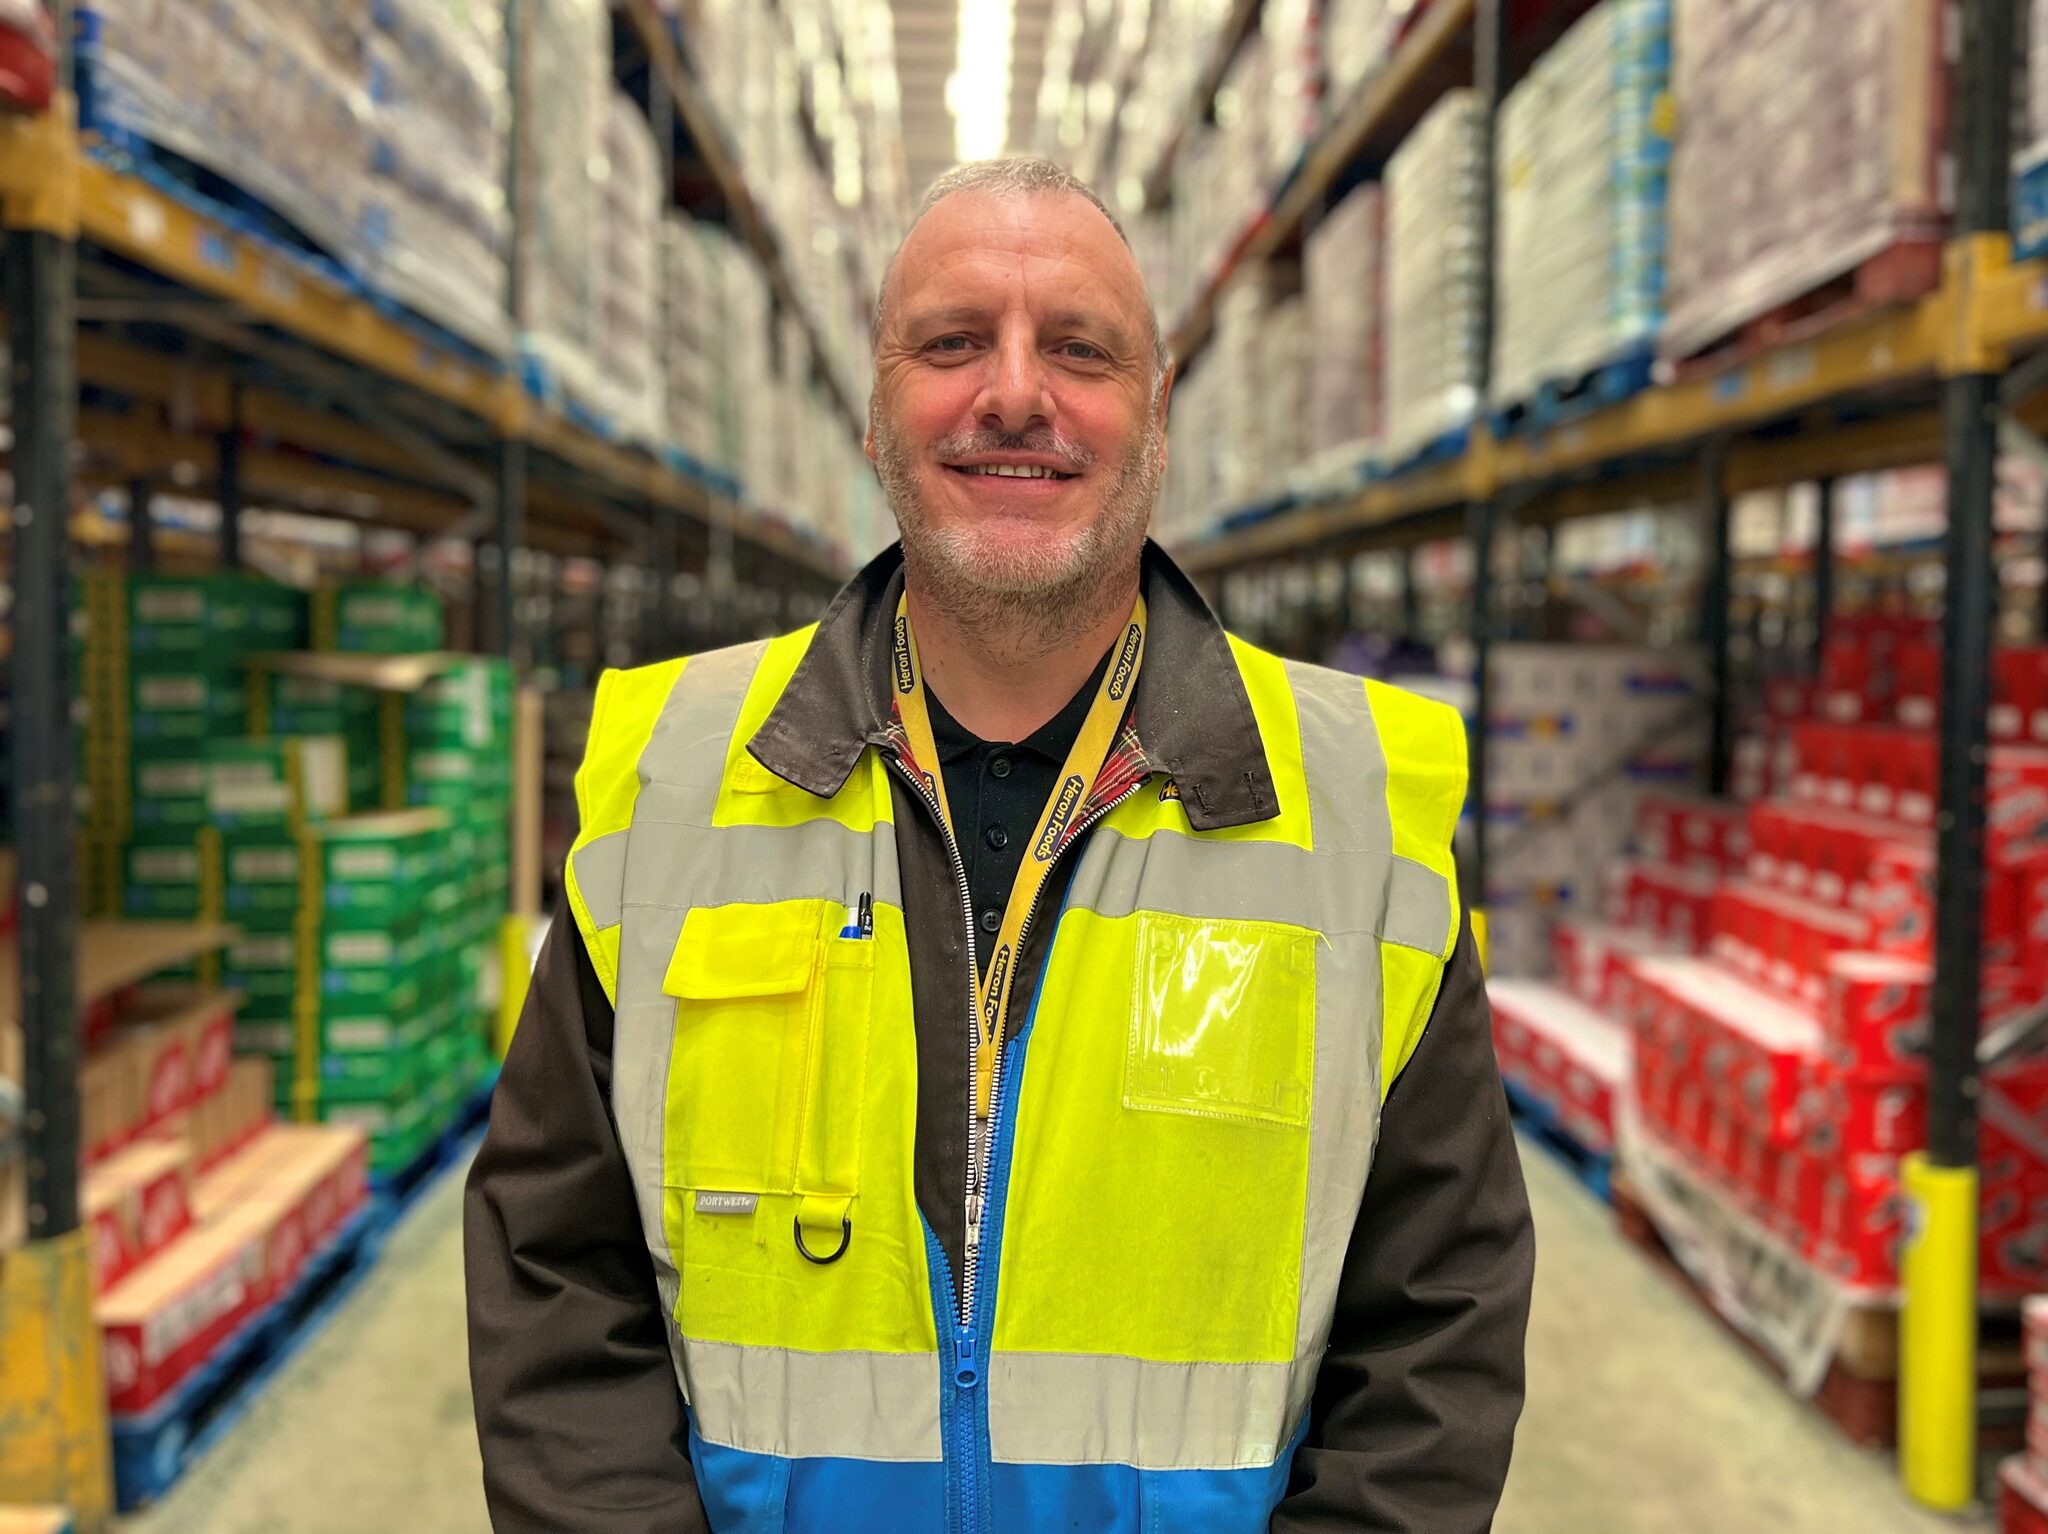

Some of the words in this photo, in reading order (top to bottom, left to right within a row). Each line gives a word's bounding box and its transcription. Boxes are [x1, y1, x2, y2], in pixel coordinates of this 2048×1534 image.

[894, 619, 907, 653] Foods
[1124, 625, 1140, 661] Heron
[898, 653, 912, 689] Heron
[1111, 660, 1131, 697] Foods
[1055, 778, 1081, 820] Heron
[1037, 820, 1064, 858] Foods
[990, 950, 1009, 996] Heron
[985, 998, 999, 1039] Foo
[700, 1195, 748, 1207] PORTWEST
